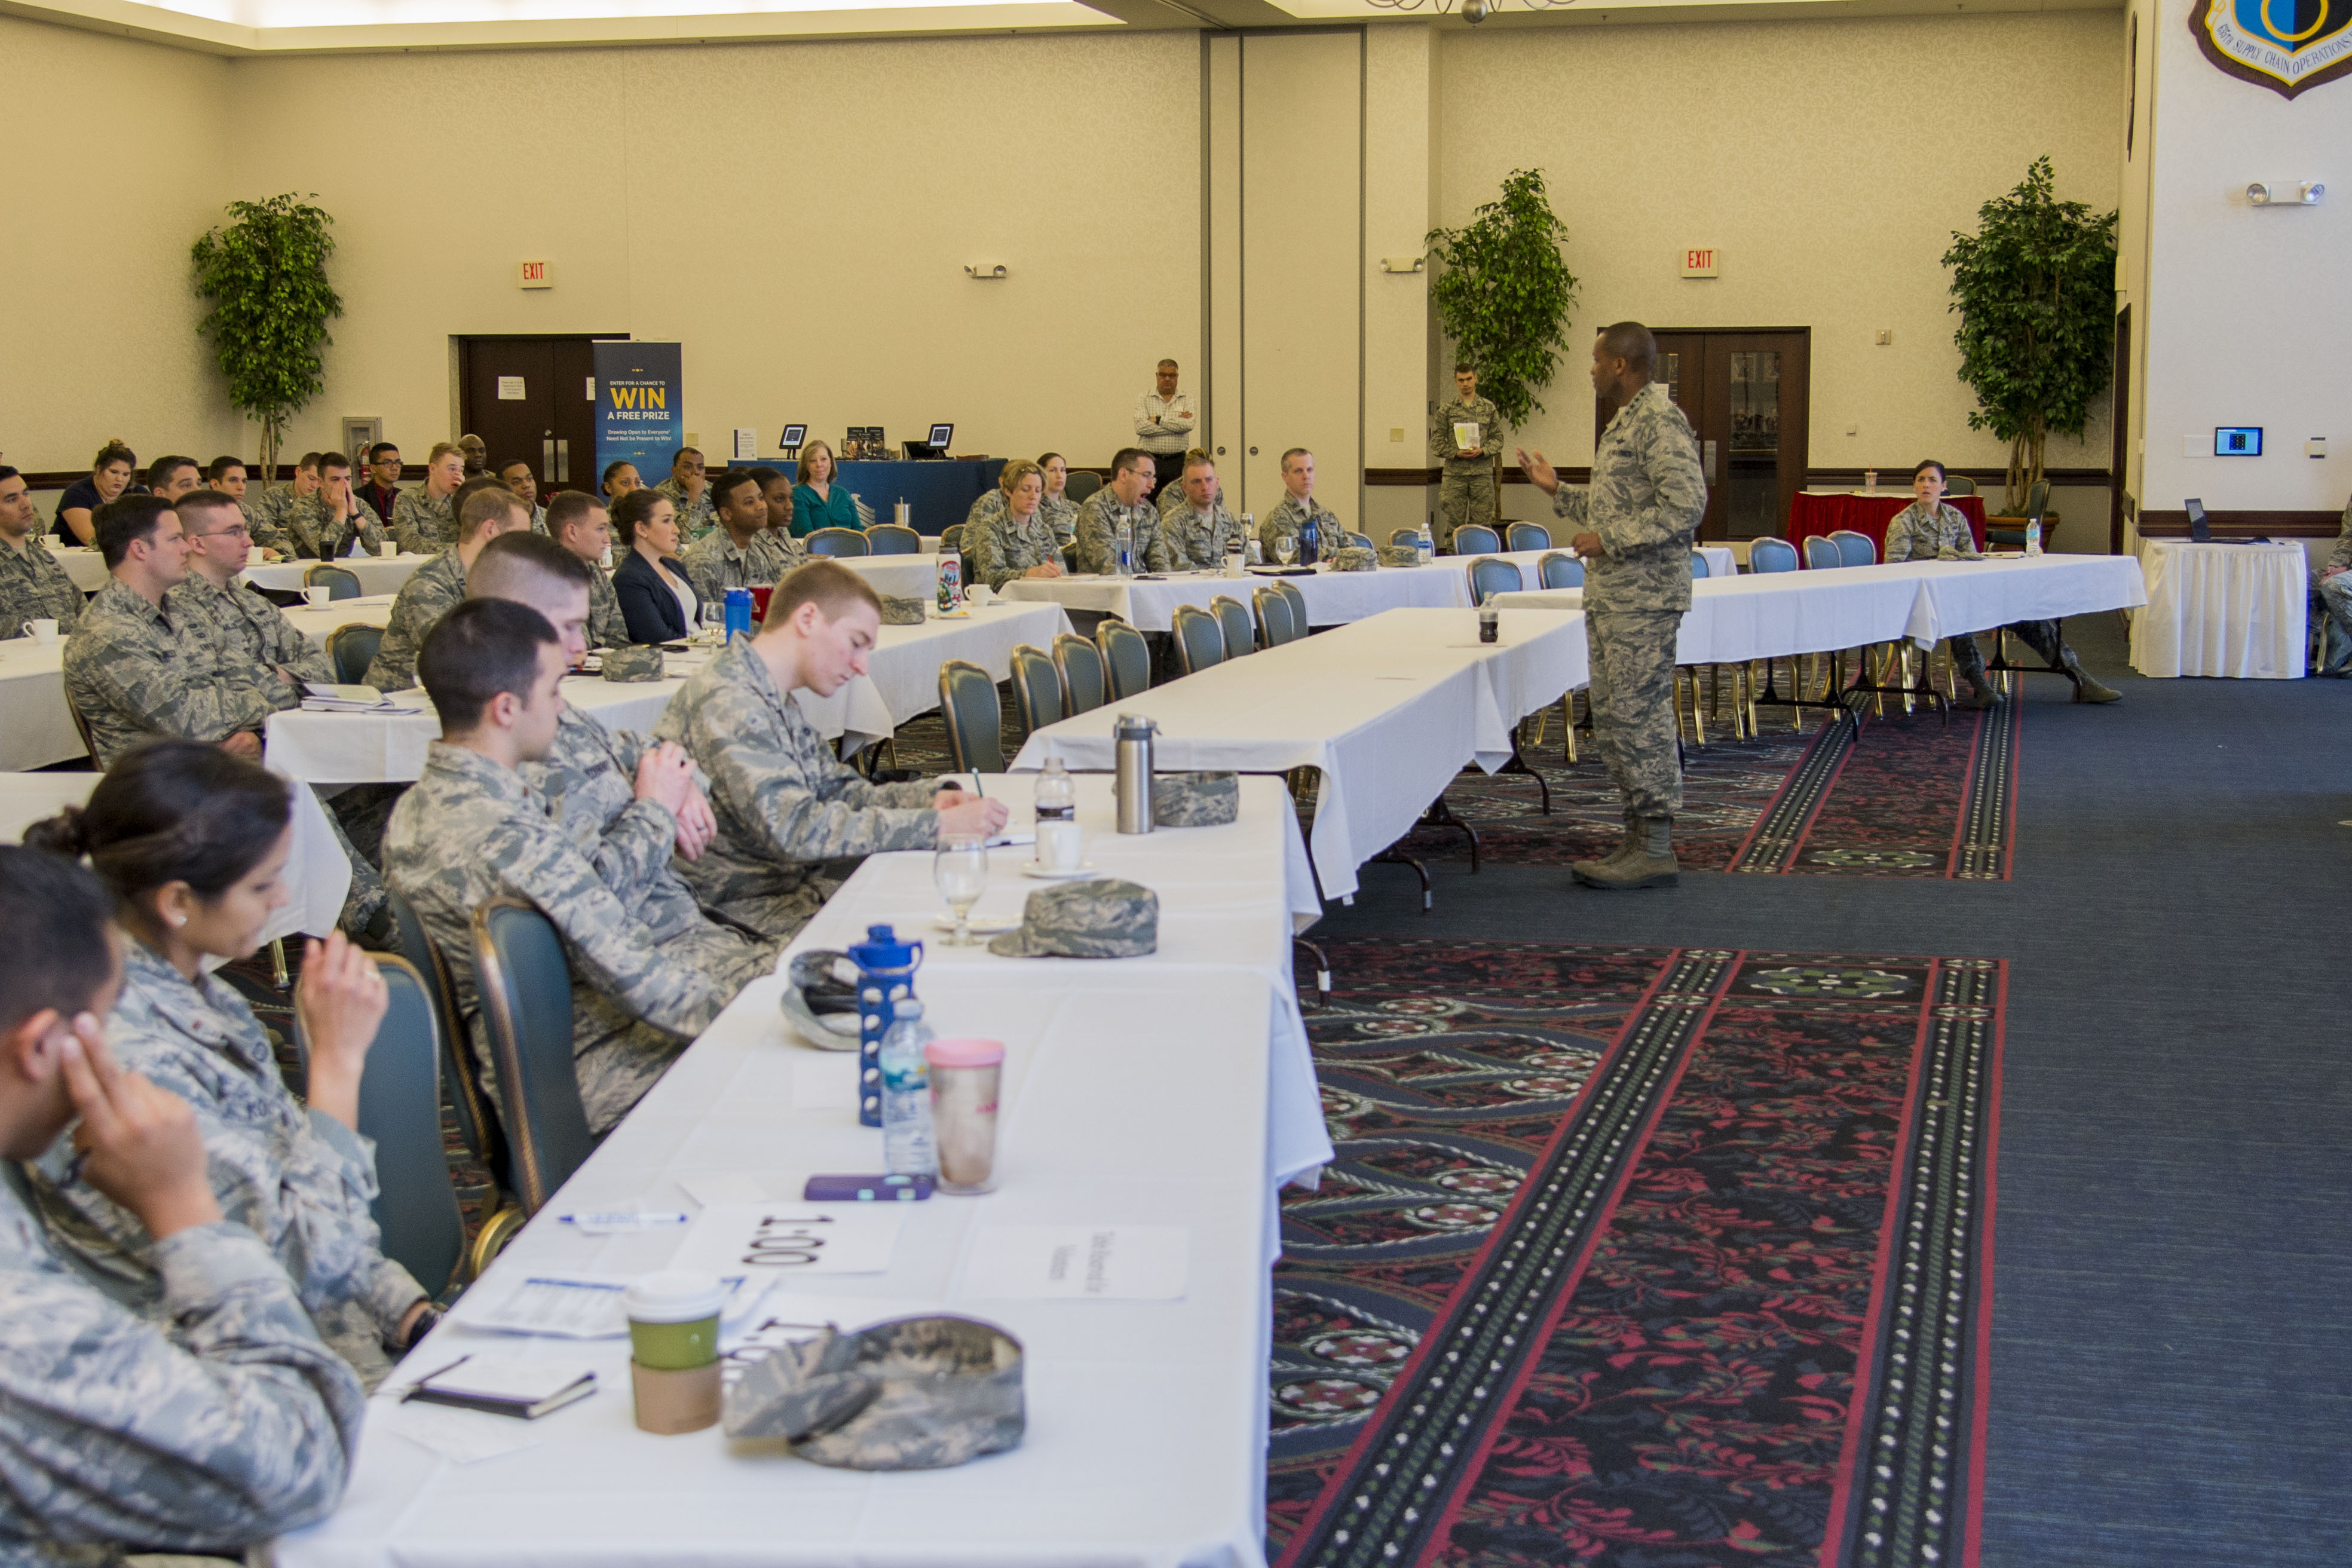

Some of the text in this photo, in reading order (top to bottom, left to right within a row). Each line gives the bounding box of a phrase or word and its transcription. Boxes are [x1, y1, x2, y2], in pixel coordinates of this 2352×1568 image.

[2232, 39, 2262, 60] SUPPLY
[2264, 51, 2289, 74] CHAIN
[2292, 36, 2351, 75] OPERATIONS
[1688, 250, 1713, 268] EXIT
[523, 262, 544, 280] EXIT
[610, 388, 665, 409] WIN
[607, 411, 670, 419] A FREE PRIZE
